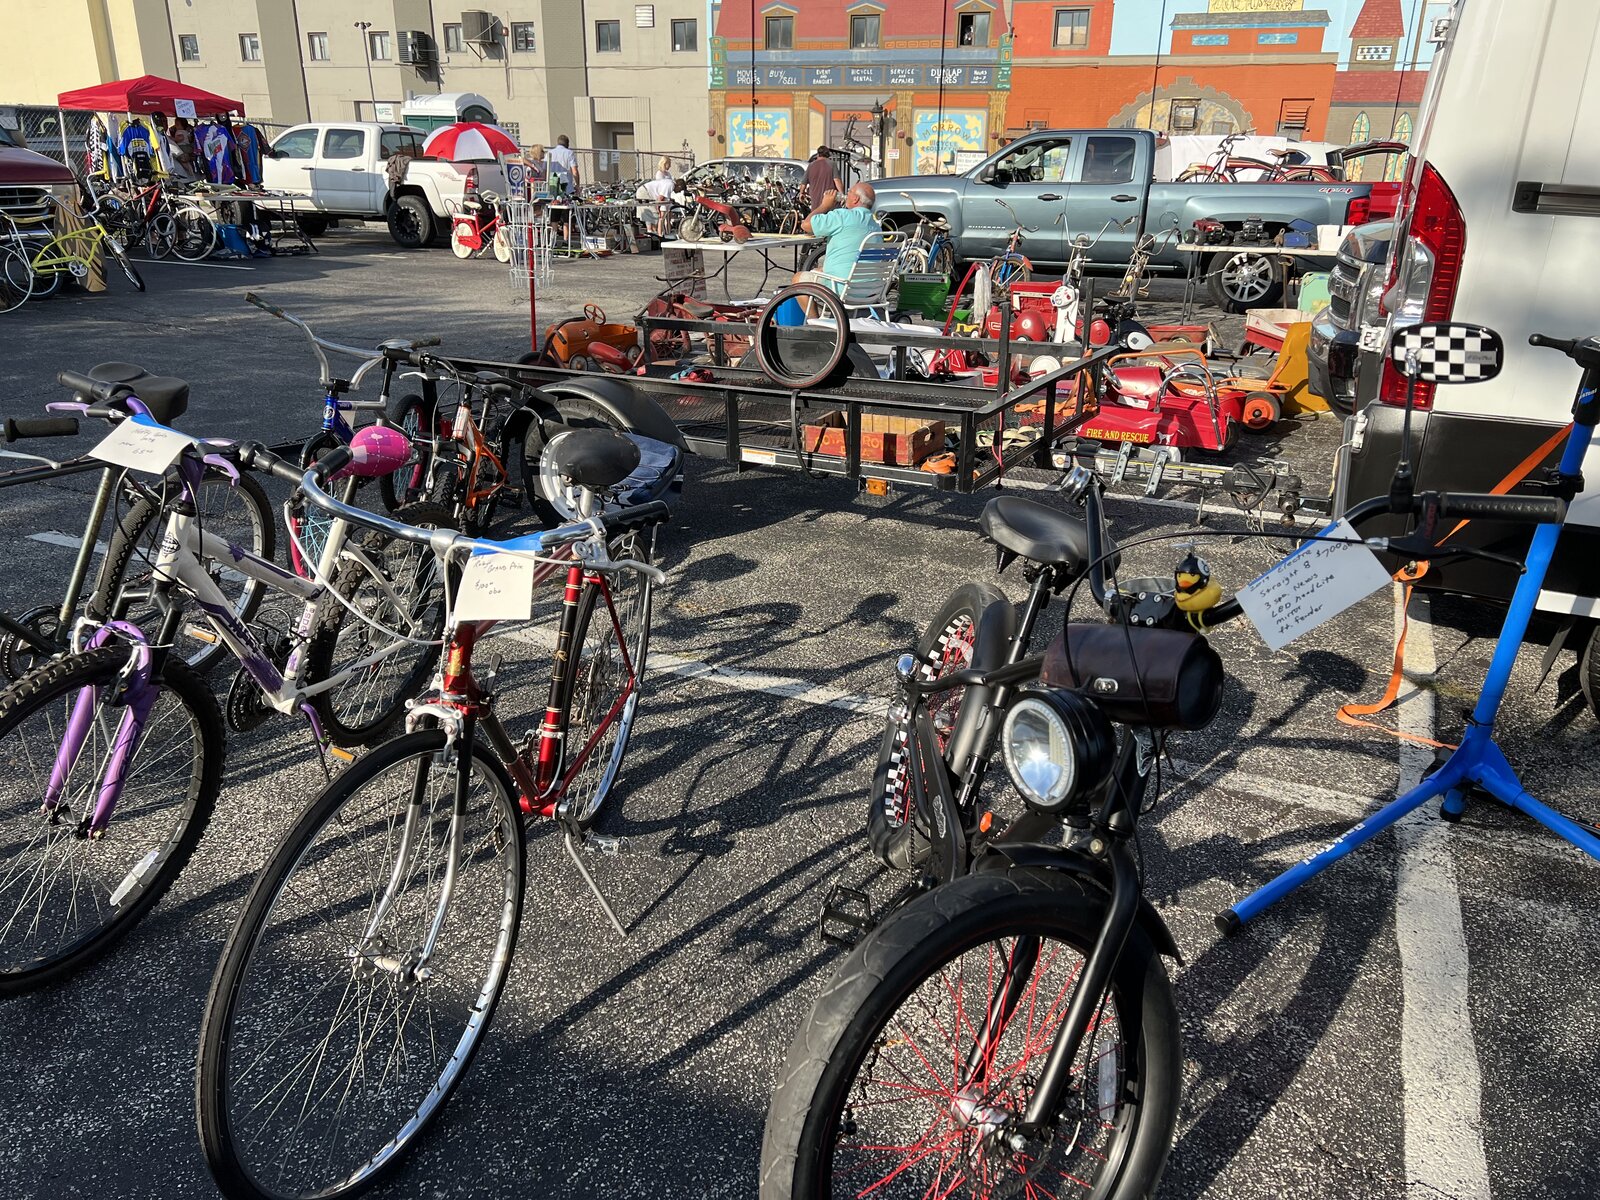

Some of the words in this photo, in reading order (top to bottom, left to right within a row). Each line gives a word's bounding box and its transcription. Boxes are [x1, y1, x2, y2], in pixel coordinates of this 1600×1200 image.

[930, 69, 963, 77] DUNLAP
[737, 77, 761, 85] PROPS
[782, 76, 797, 85] SELL
[934, 76, 958, 84] TIRES
[922, 123, 971, 140] MORROW
[1086, 428, 1103, 439] FIRE
[1104, 430, 1120, 439] AND
[1121, 431, 1150, 443] RESCUE
[1264, 601, 1272, 610] 3
